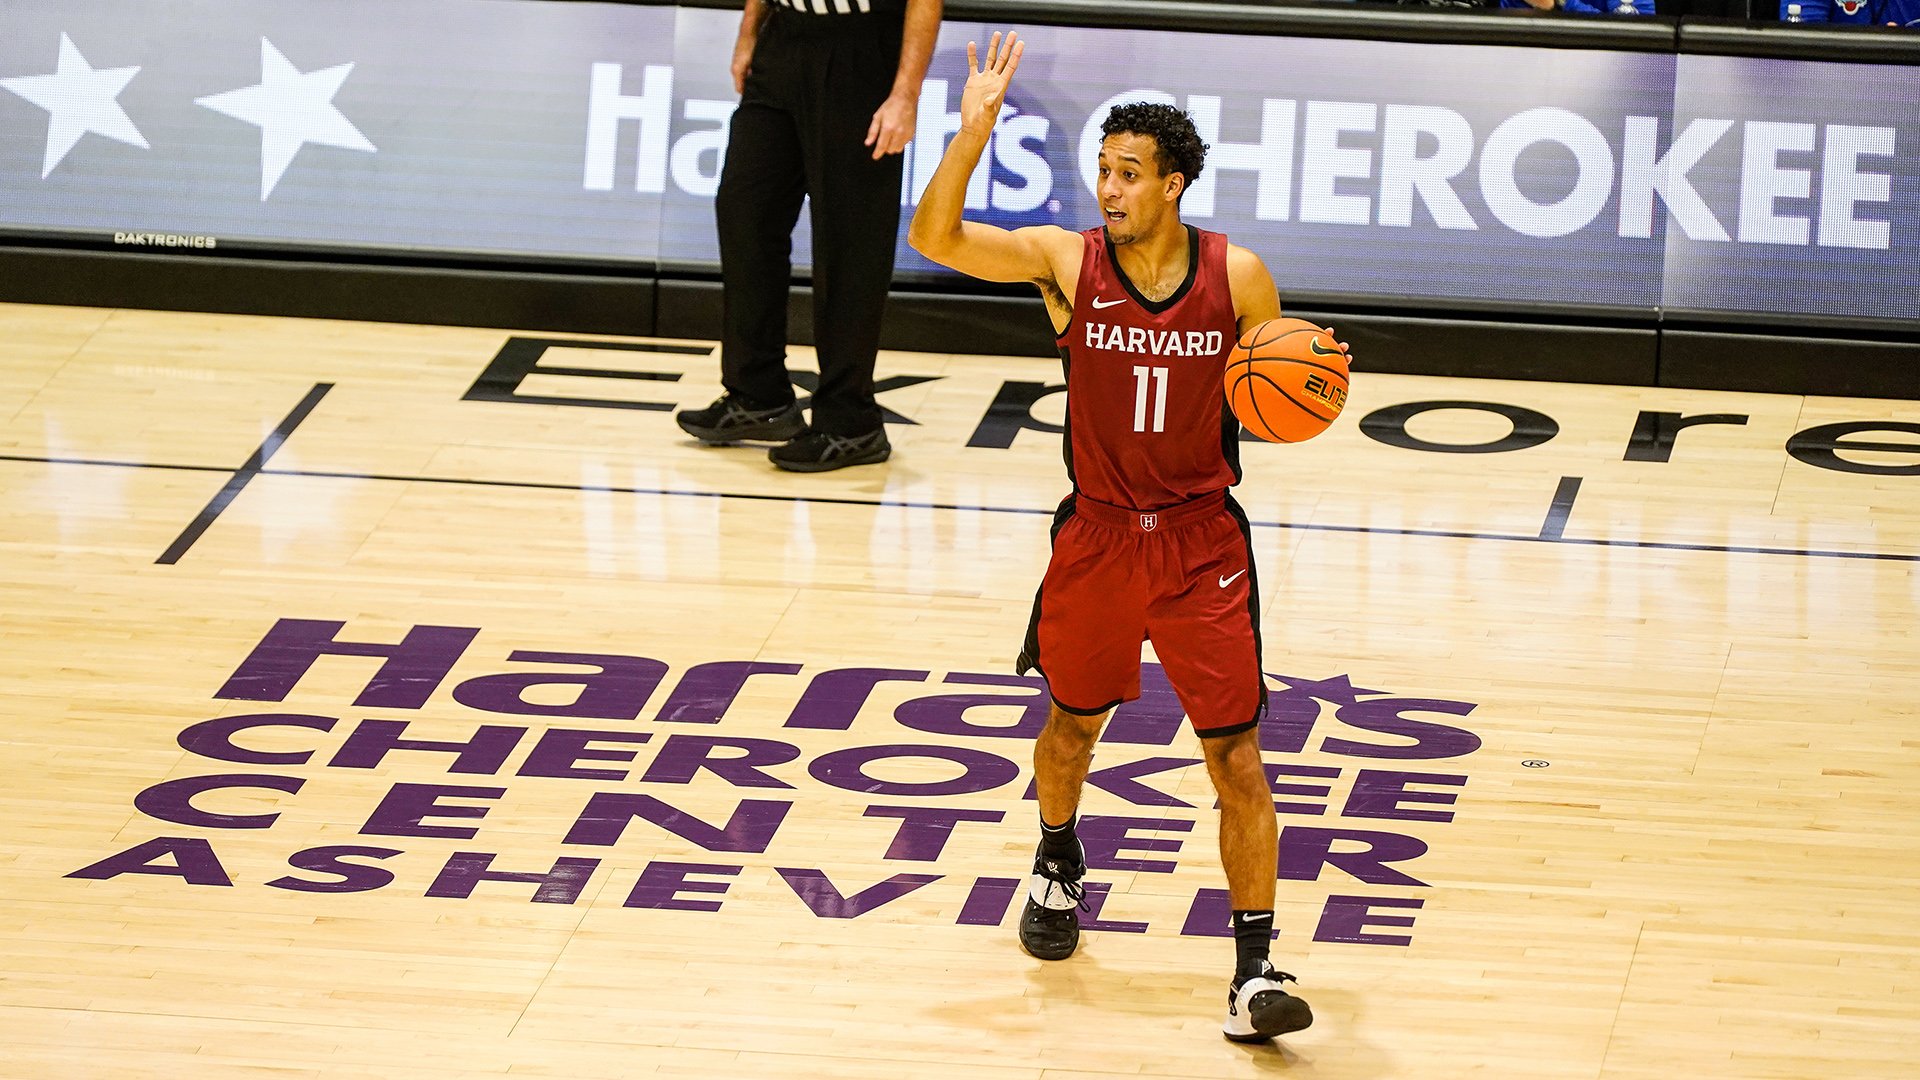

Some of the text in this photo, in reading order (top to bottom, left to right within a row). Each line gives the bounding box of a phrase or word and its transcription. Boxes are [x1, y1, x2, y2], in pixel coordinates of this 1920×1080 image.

[1078, 88, 1897, 250] CHEROKEE
[113, 232, 216, 249] DAKTRONICS
[1086, 322, 1222, 356] HARVARD
[1133, 365, 1169, 432] 11
[1303, 372, 1348, 409] ELITE
[1144, 516, 1153, 528] H
[177, 713, 1468, 823] CHEROKEE
[134, 773, 1432, 887] CENTER
[63, 836, 1424, 946] ASHEVILLE
